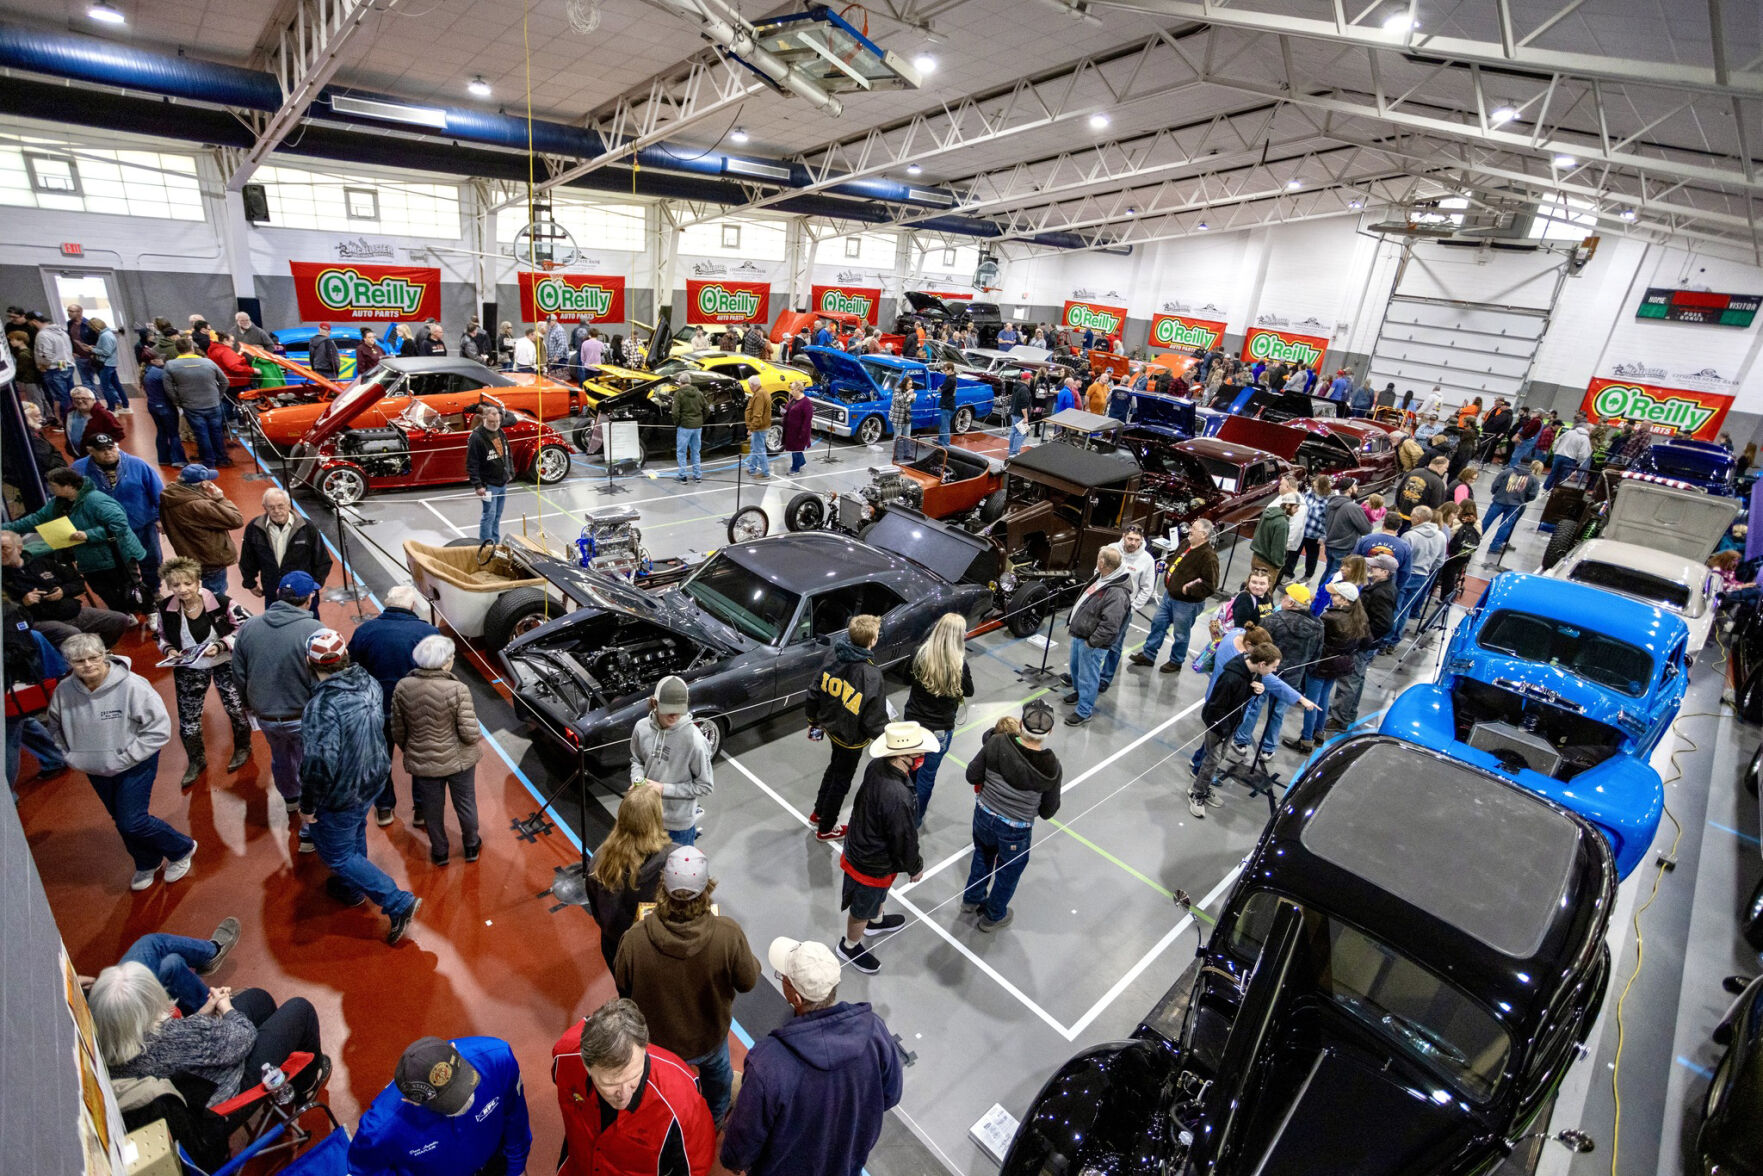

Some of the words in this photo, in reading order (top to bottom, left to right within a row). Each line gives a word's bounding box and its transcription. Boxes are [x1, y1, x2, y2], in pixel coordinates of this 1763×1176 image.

[322, 273, 419, 310] O'Reilly
[539, 282, 609, 313] O'Reilly
[701, 288, 757, 315] O'Reilly
[823, 292, 870, 317] O'Reilly
[1648, 296, 1666, 304] HOME
[1728, 301, 1757, 311] VISITOR
[351, 309, 373, 318] AUTO
[374, 310, 400, 318] PARTS
[1069, 306, 1117, 334] O'Reilly
[1158, 320, 1214, 350] O'Reilly
[1253, 334, 1317, 366] O'Reilly
[1599, 388, 1708, 430] O'Reilly
[820, 671, 864, 717] IOWA
